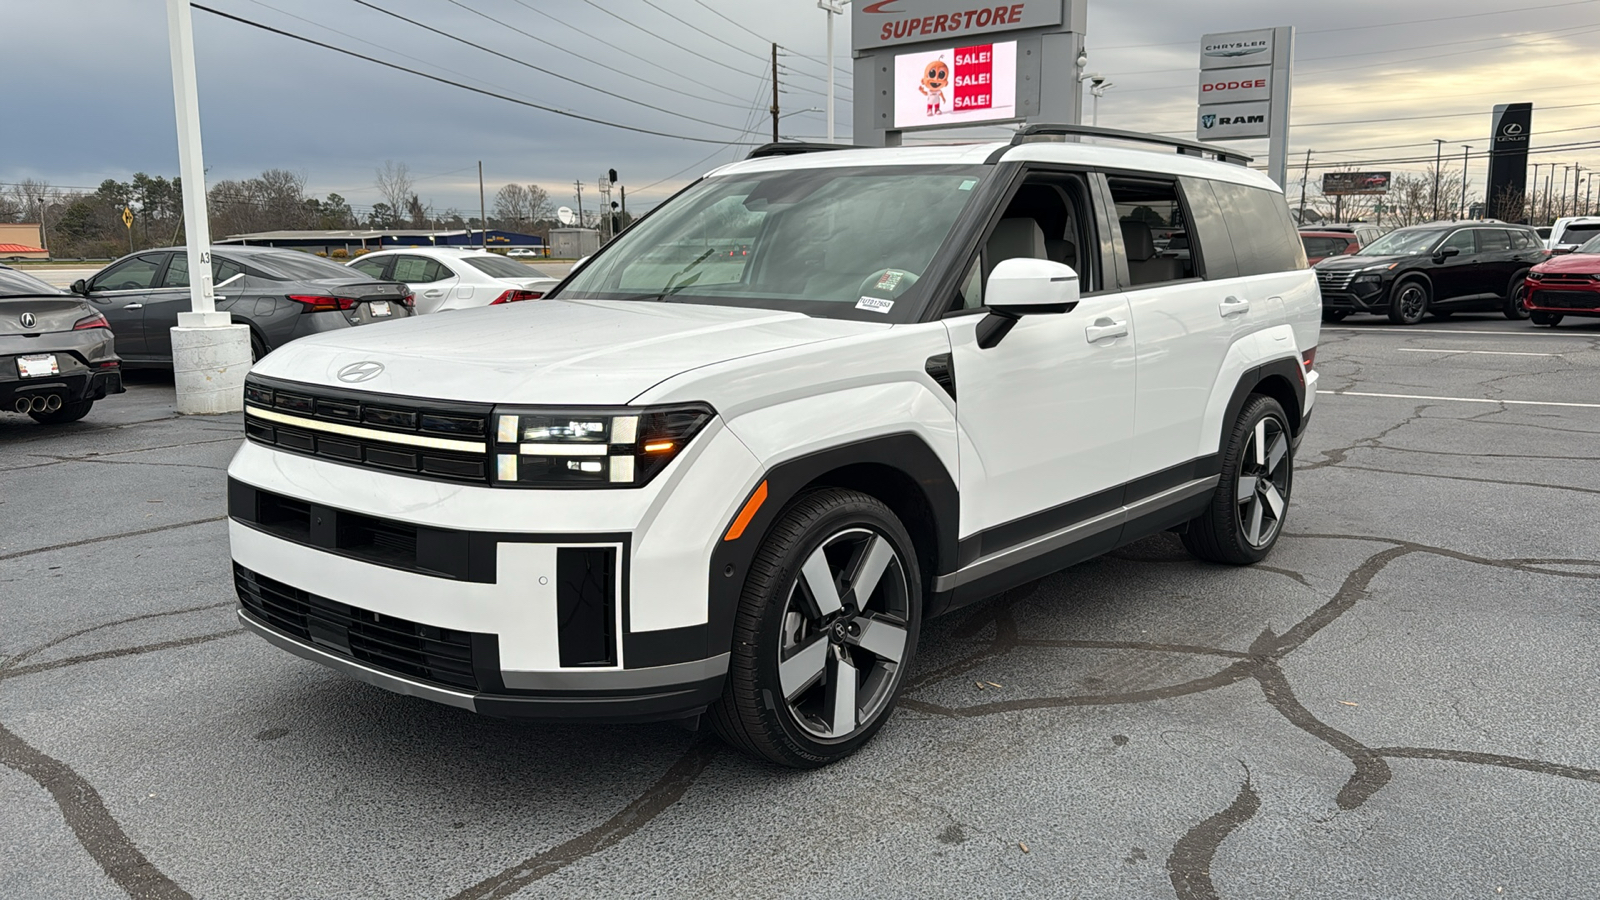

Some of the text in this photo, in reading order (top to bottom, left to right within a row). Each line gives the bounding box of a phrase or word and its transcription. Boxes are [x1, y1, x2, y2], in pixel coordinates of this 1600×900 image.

[880, 4, 1024, 41] SUPERSTORE
[1205, 40, 1266, 51] CHRYSLER
[955, 51, 991, 66] SALE!
[955, 74, 990, 87] SALE!
[1202, 79, 1266, 92] DODGE
[954, 95, 990, 108] SALE!
[1219, 115, 1264, 125] RAM
[200, 252, 210, 264] A3
